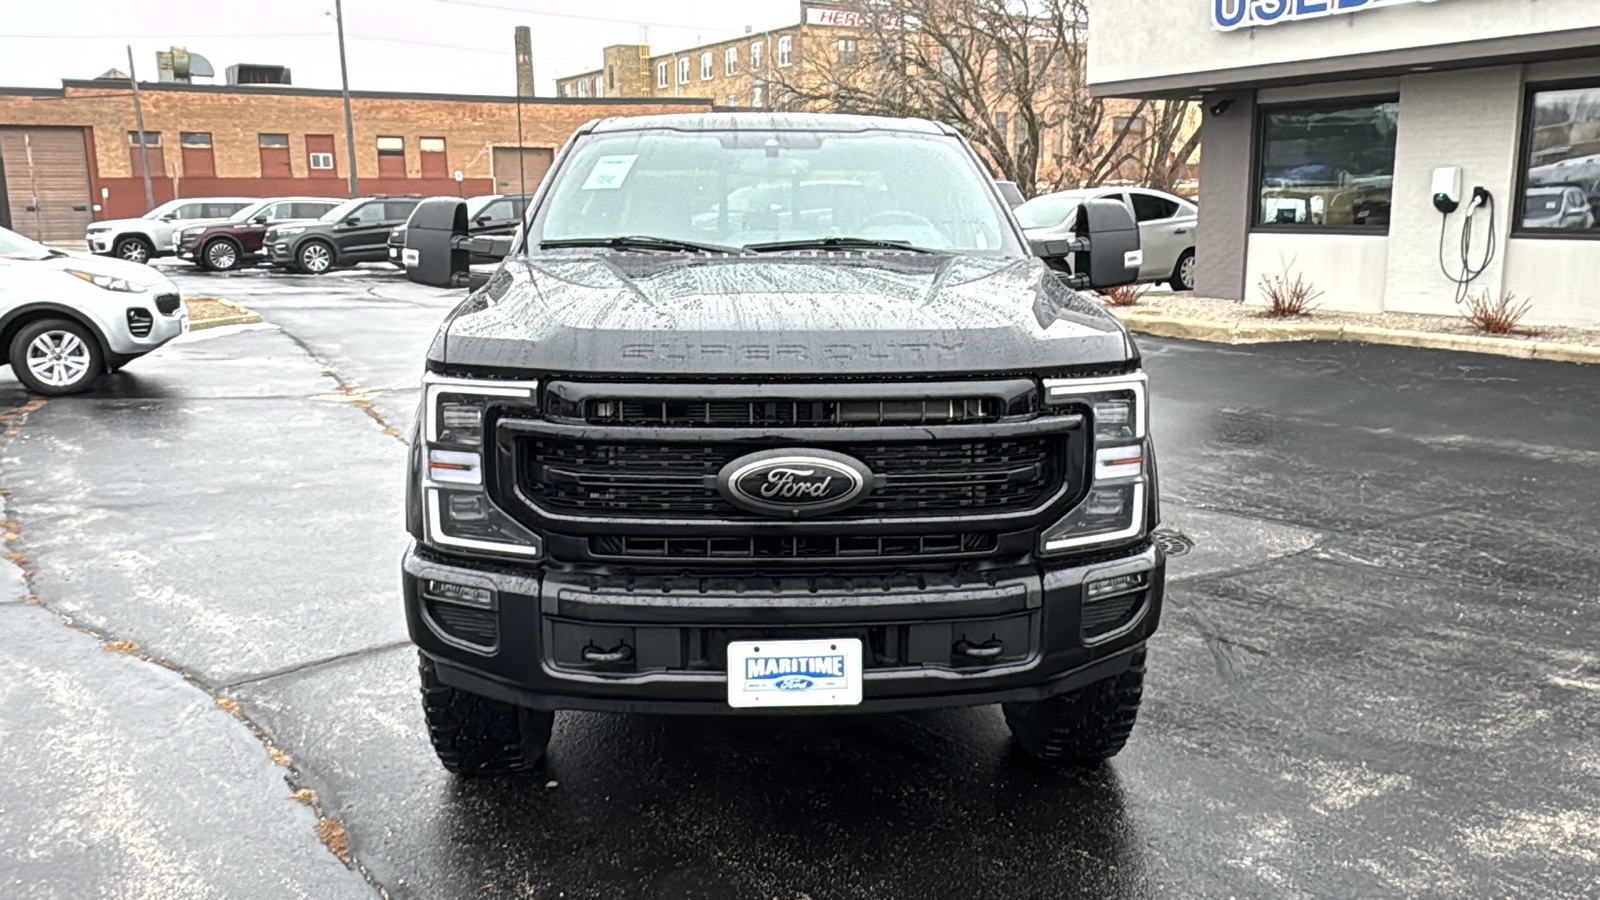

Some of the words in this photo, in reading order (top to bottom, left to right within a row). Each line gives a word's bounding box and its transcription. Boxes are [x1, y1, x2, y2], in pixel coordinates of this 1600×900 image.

[621, 343, 811, 361] SUPER
[823, 342, 964, 361] DUTY
[760, 468, 832, 497] Ford
[747, 656, 843, 678] MARITIME
[780, 678, 809, 690] Ford
